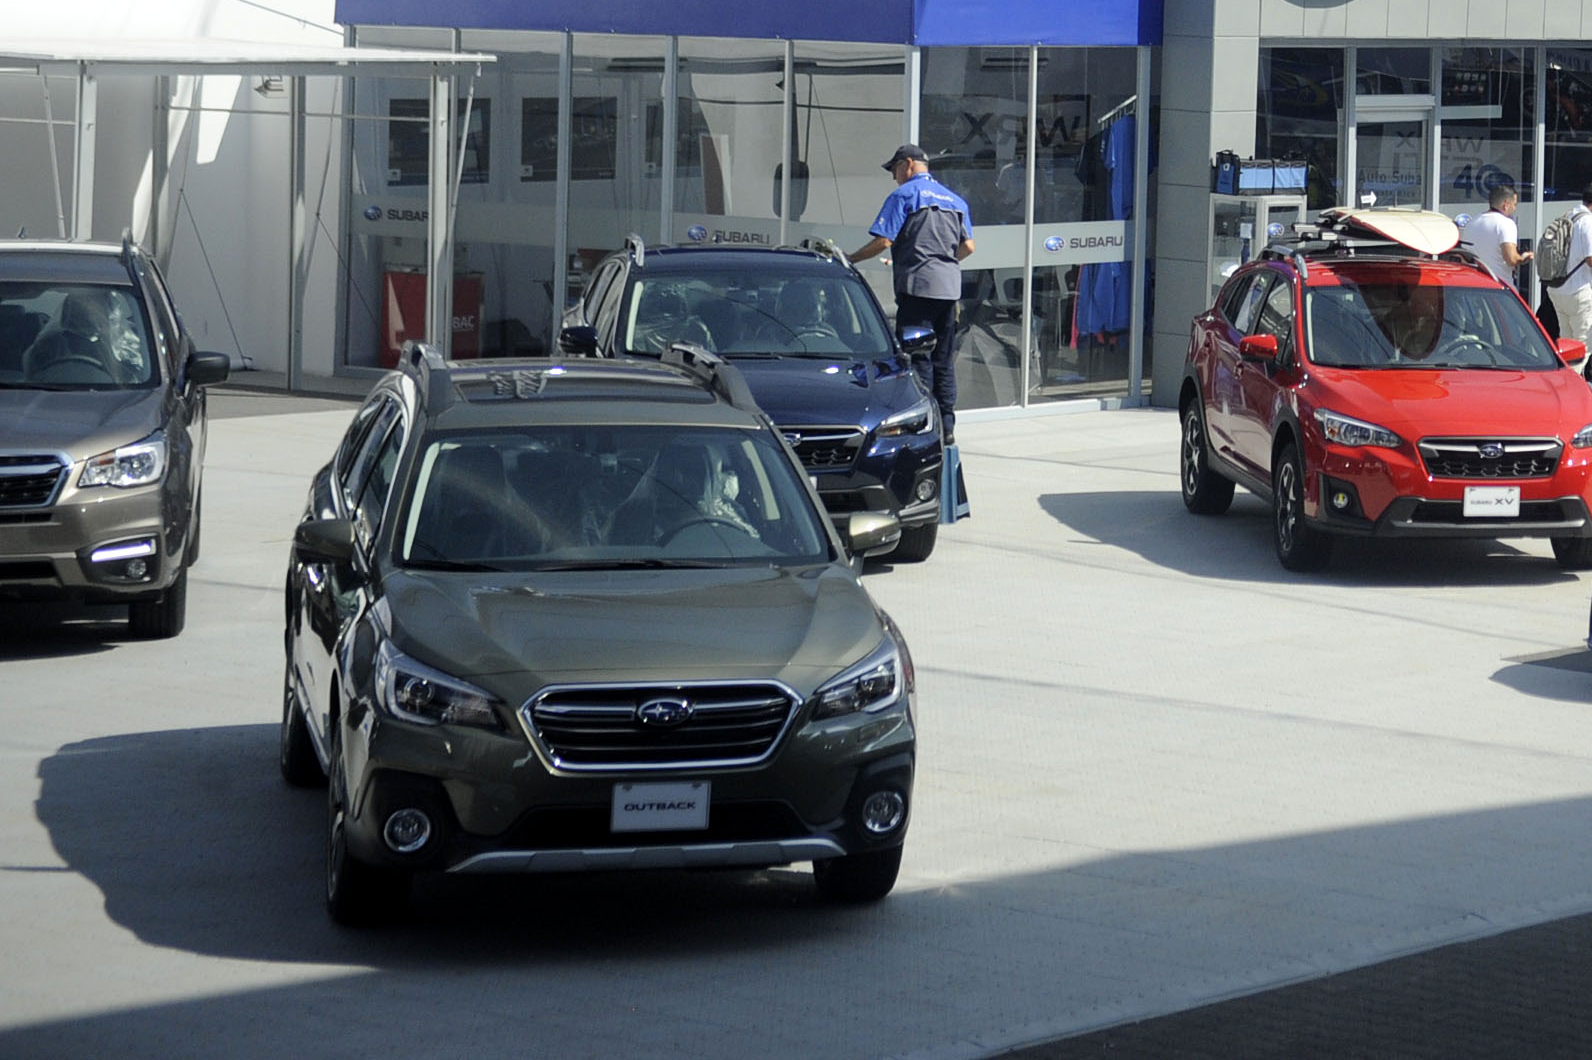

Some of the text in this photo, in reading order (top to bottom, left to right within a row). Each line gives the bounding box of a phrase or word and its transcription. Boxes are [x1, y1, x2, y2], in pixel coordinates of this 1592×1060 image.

[1070, 236, 1123, 249] SUBARU
[1495, 498, 1514, 506] XV
[623, 801, 697, 812] OUTBACK
